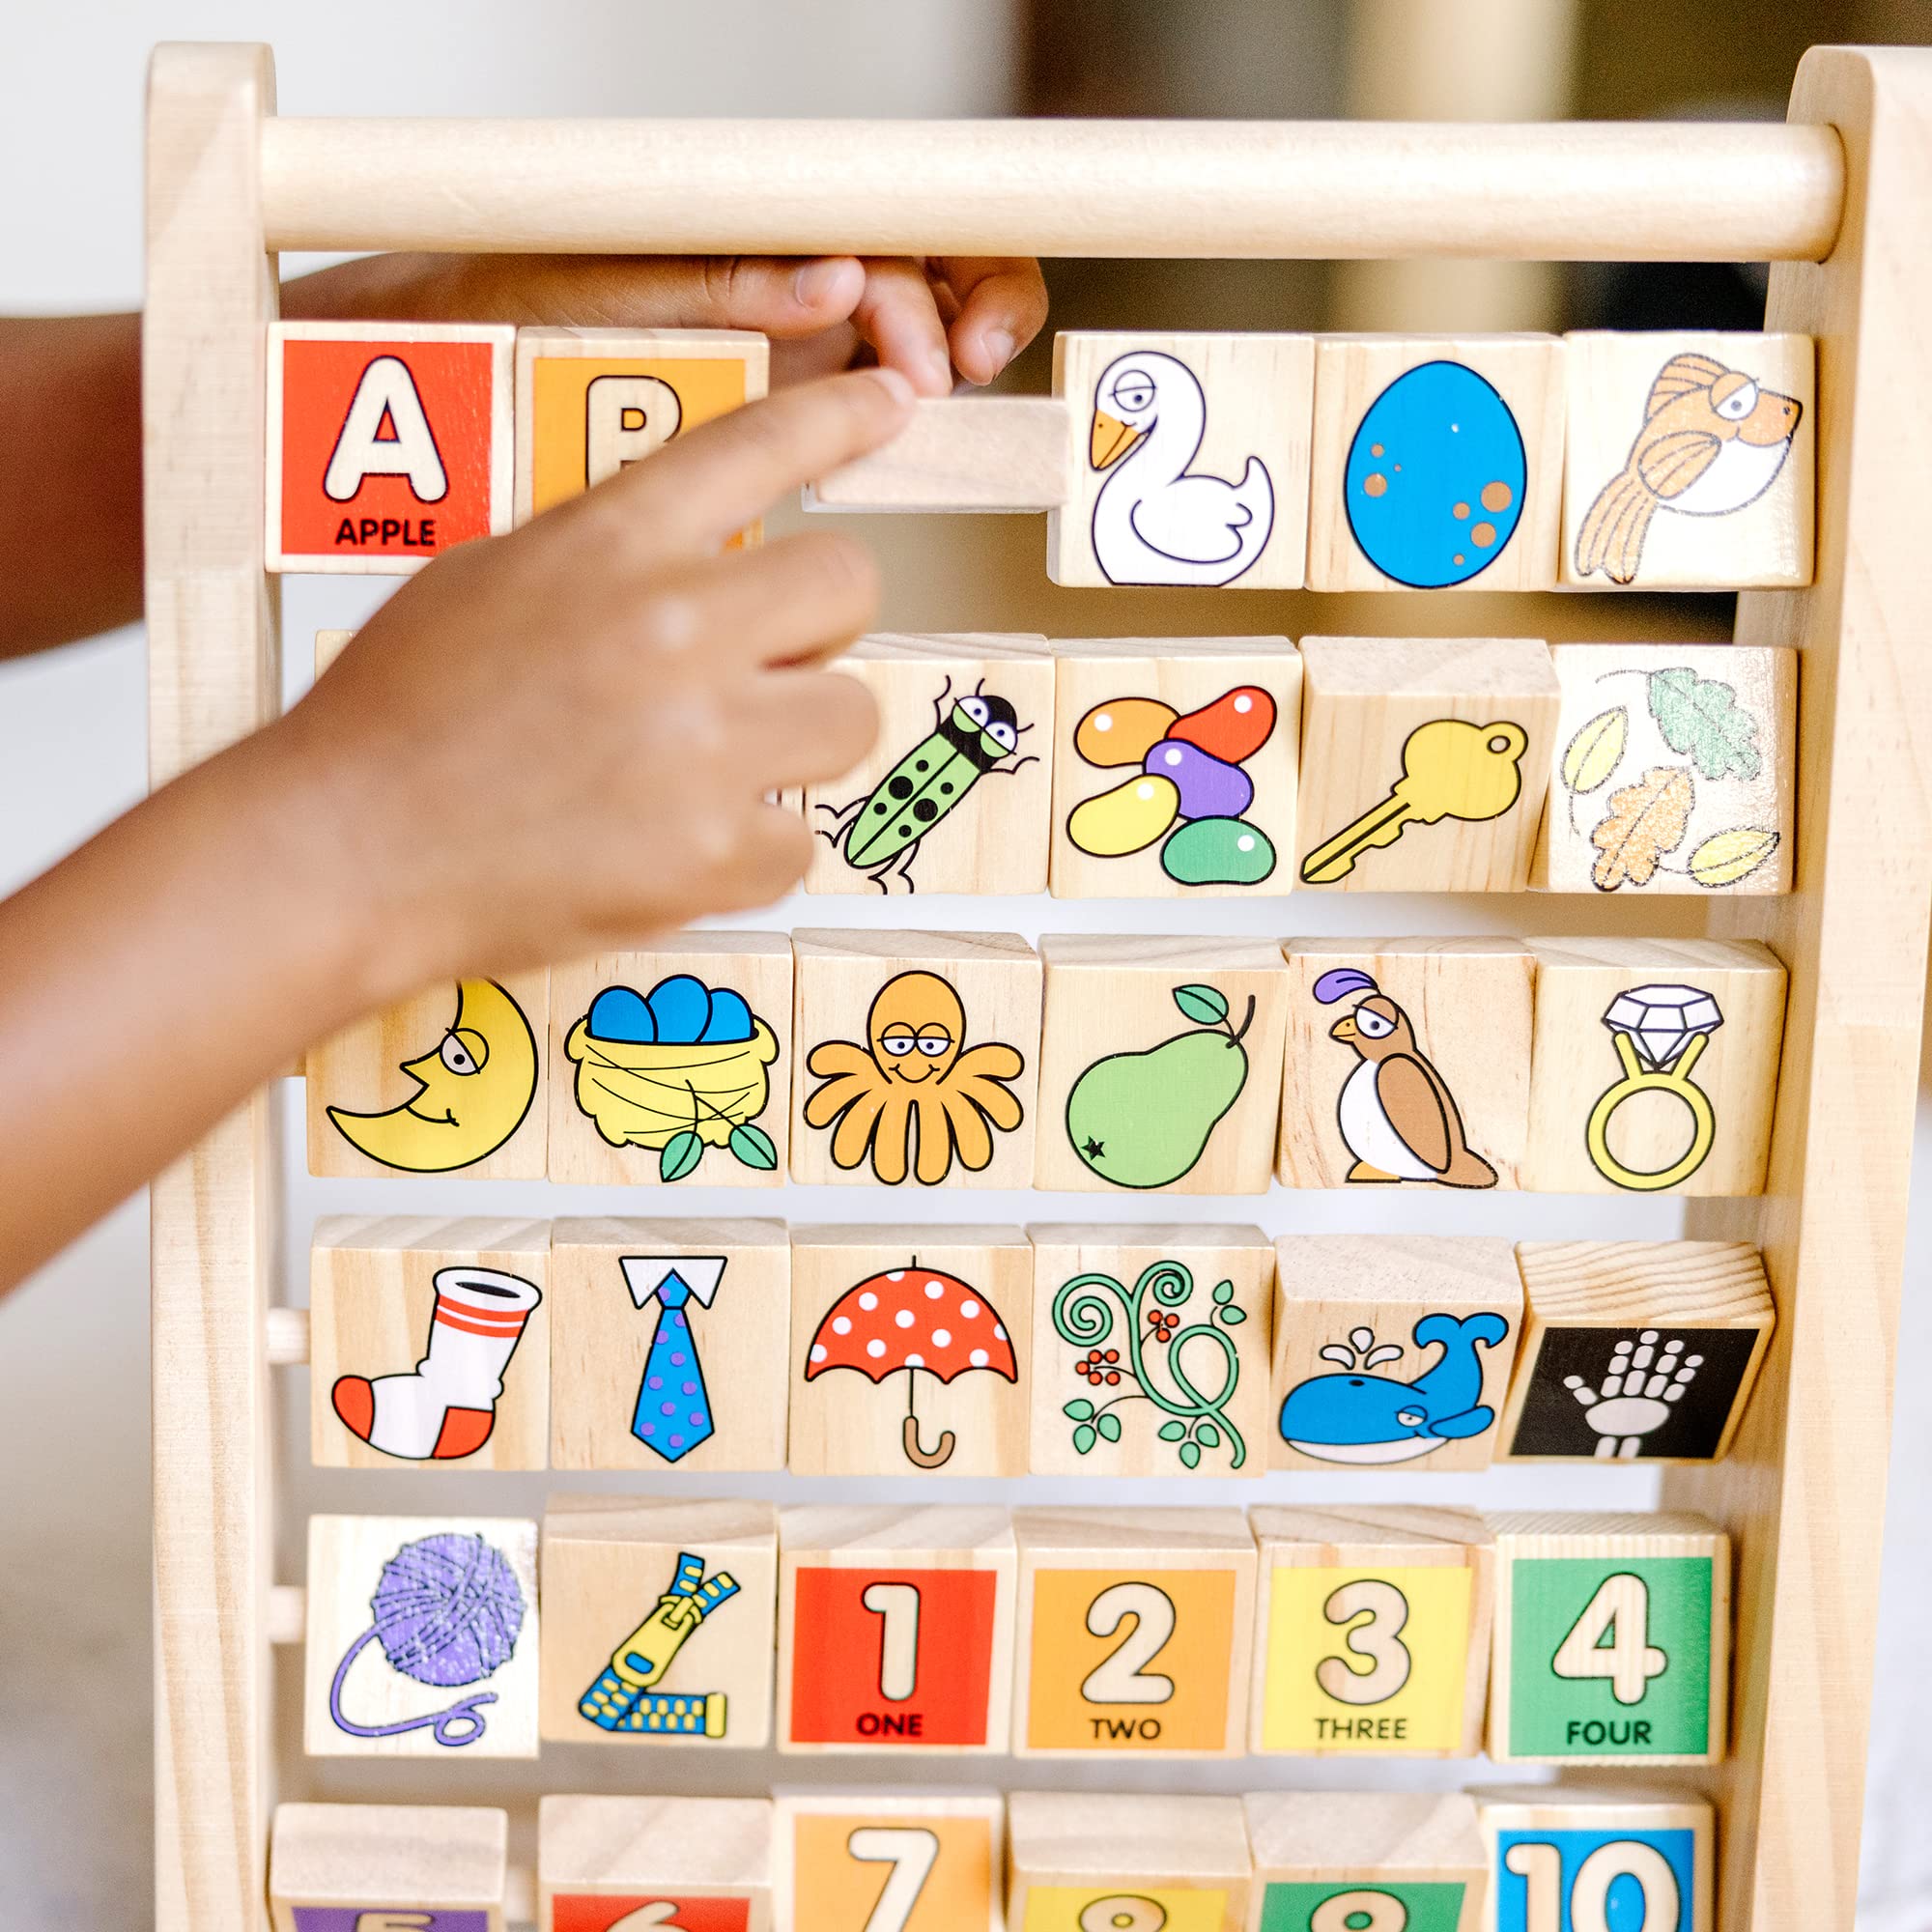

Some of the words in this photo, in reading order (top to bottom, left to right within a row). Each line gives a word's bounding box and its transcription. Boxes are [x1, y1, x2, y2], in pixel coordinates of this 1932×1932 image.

[323, 354, 449, 503] A
[334, 518, 437, 546] APPLE
[861, 1581, 921, 1702] 1
[1080, 1581, 1177, 1704] 2
[1315, 1578, 1412, 1706] 3
[1551, 1571, 1668, 1706] 4
[856, 1712, 923, 1737] ONE
[1090, 1718, 1162, 1741] TWO
[1314, 1718, 1409, 1740] THREE
[1566, 1719, 1652, 1746] FOUR
[847, 1827, 939, 1932] 7
[1504, 1839, 1683, 1932] 10
